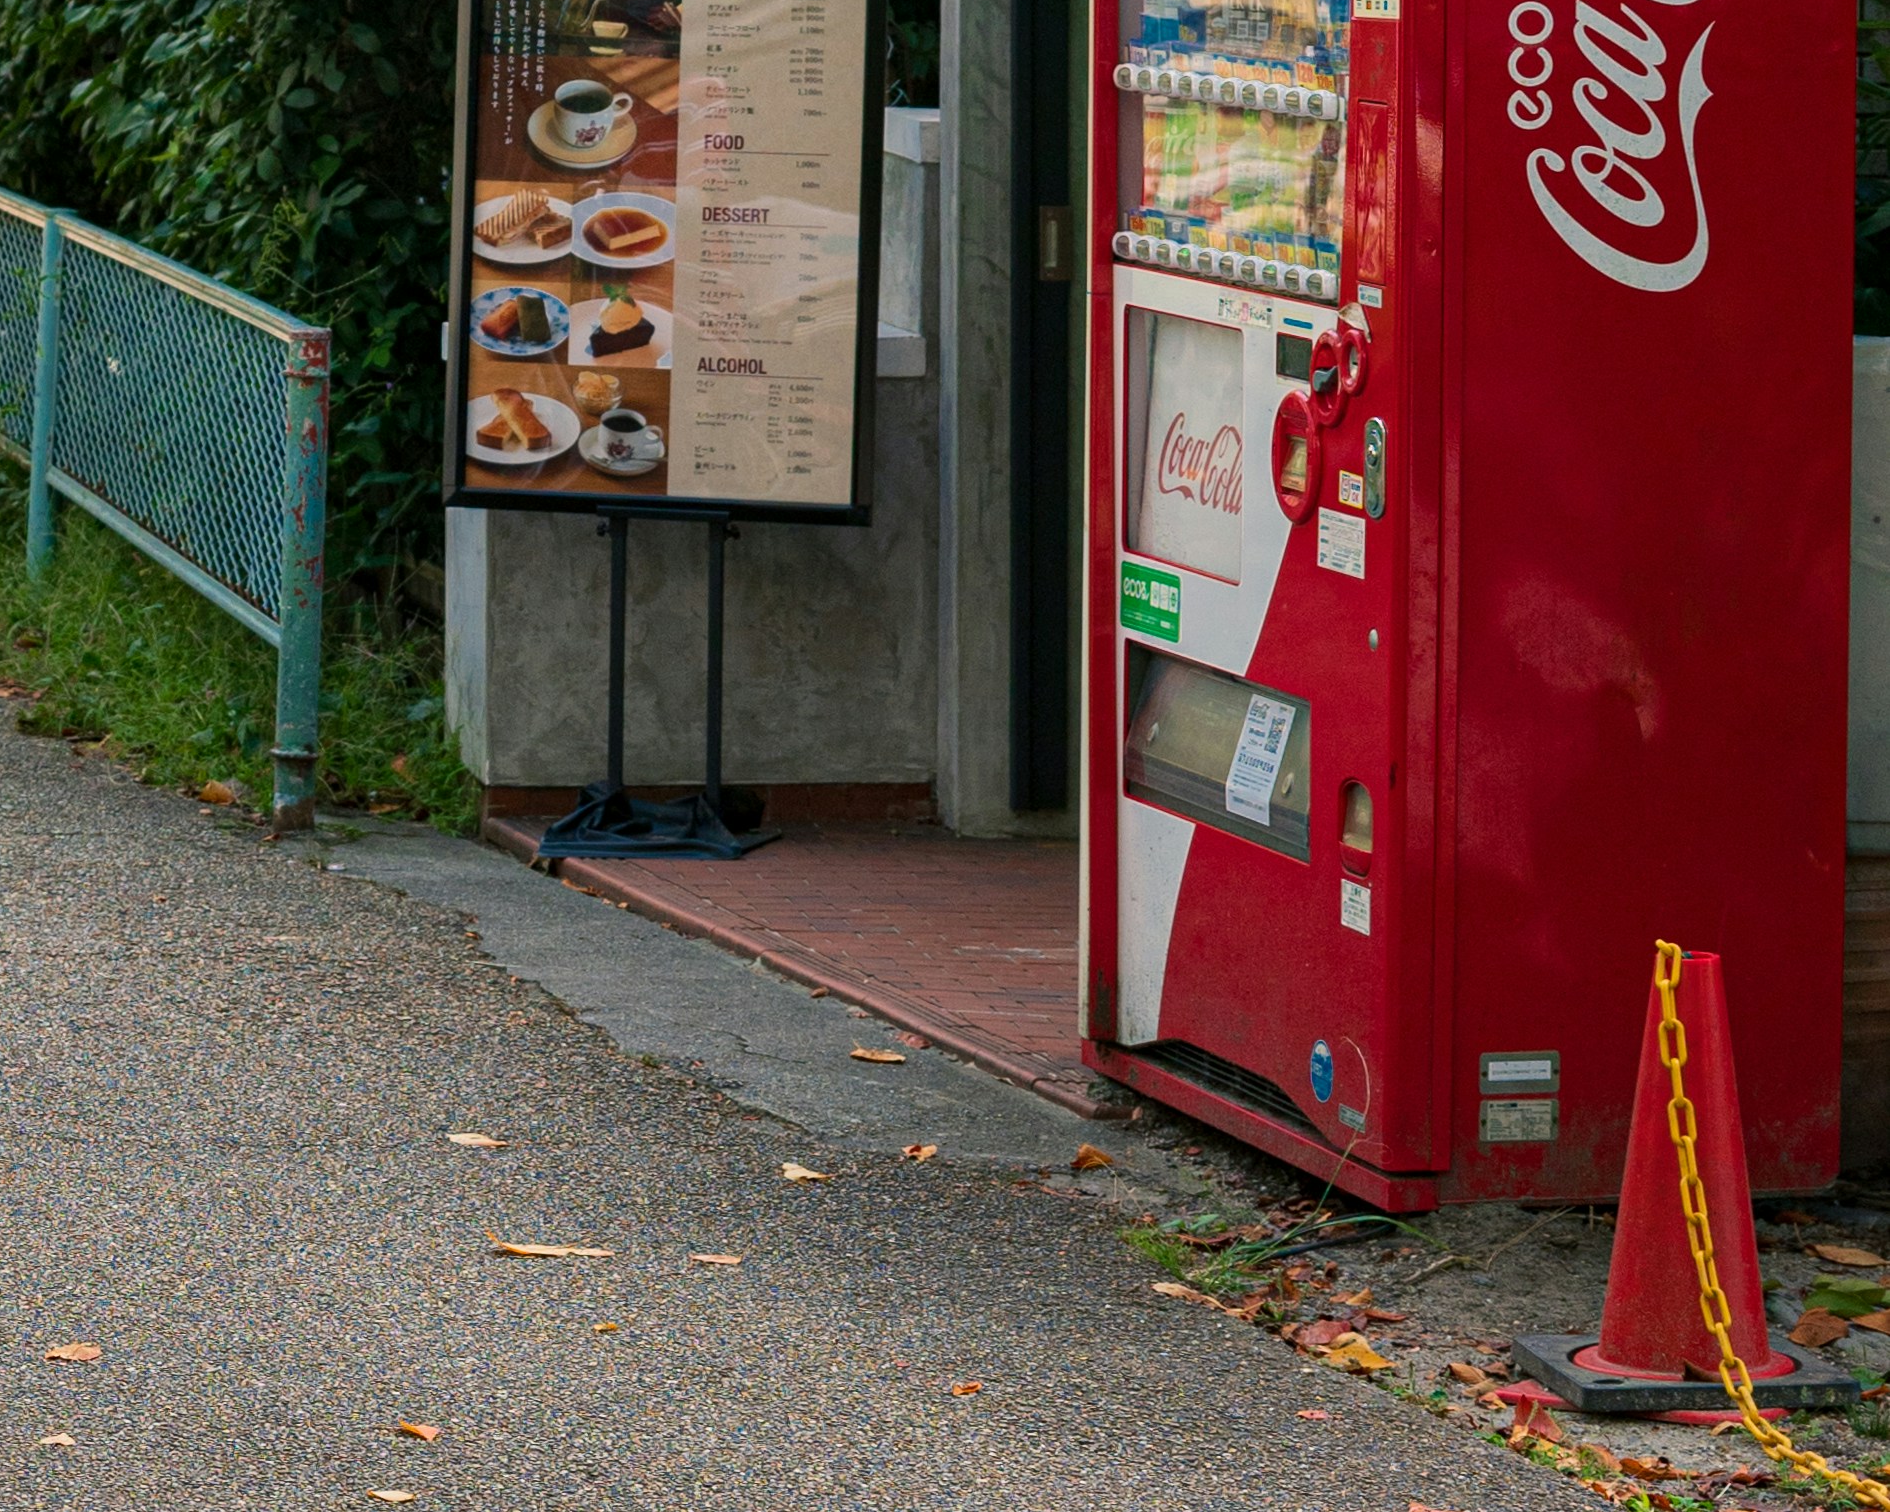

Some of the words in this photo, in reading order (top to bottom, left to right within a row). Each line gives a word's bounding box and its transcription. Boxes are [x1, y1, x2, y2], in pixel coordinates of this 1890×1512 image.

[704, 134, 745, 150] FOOD
[702, 206, 770, 224] DESSERT
[697, 357, 768, 374] ALCOHOL
